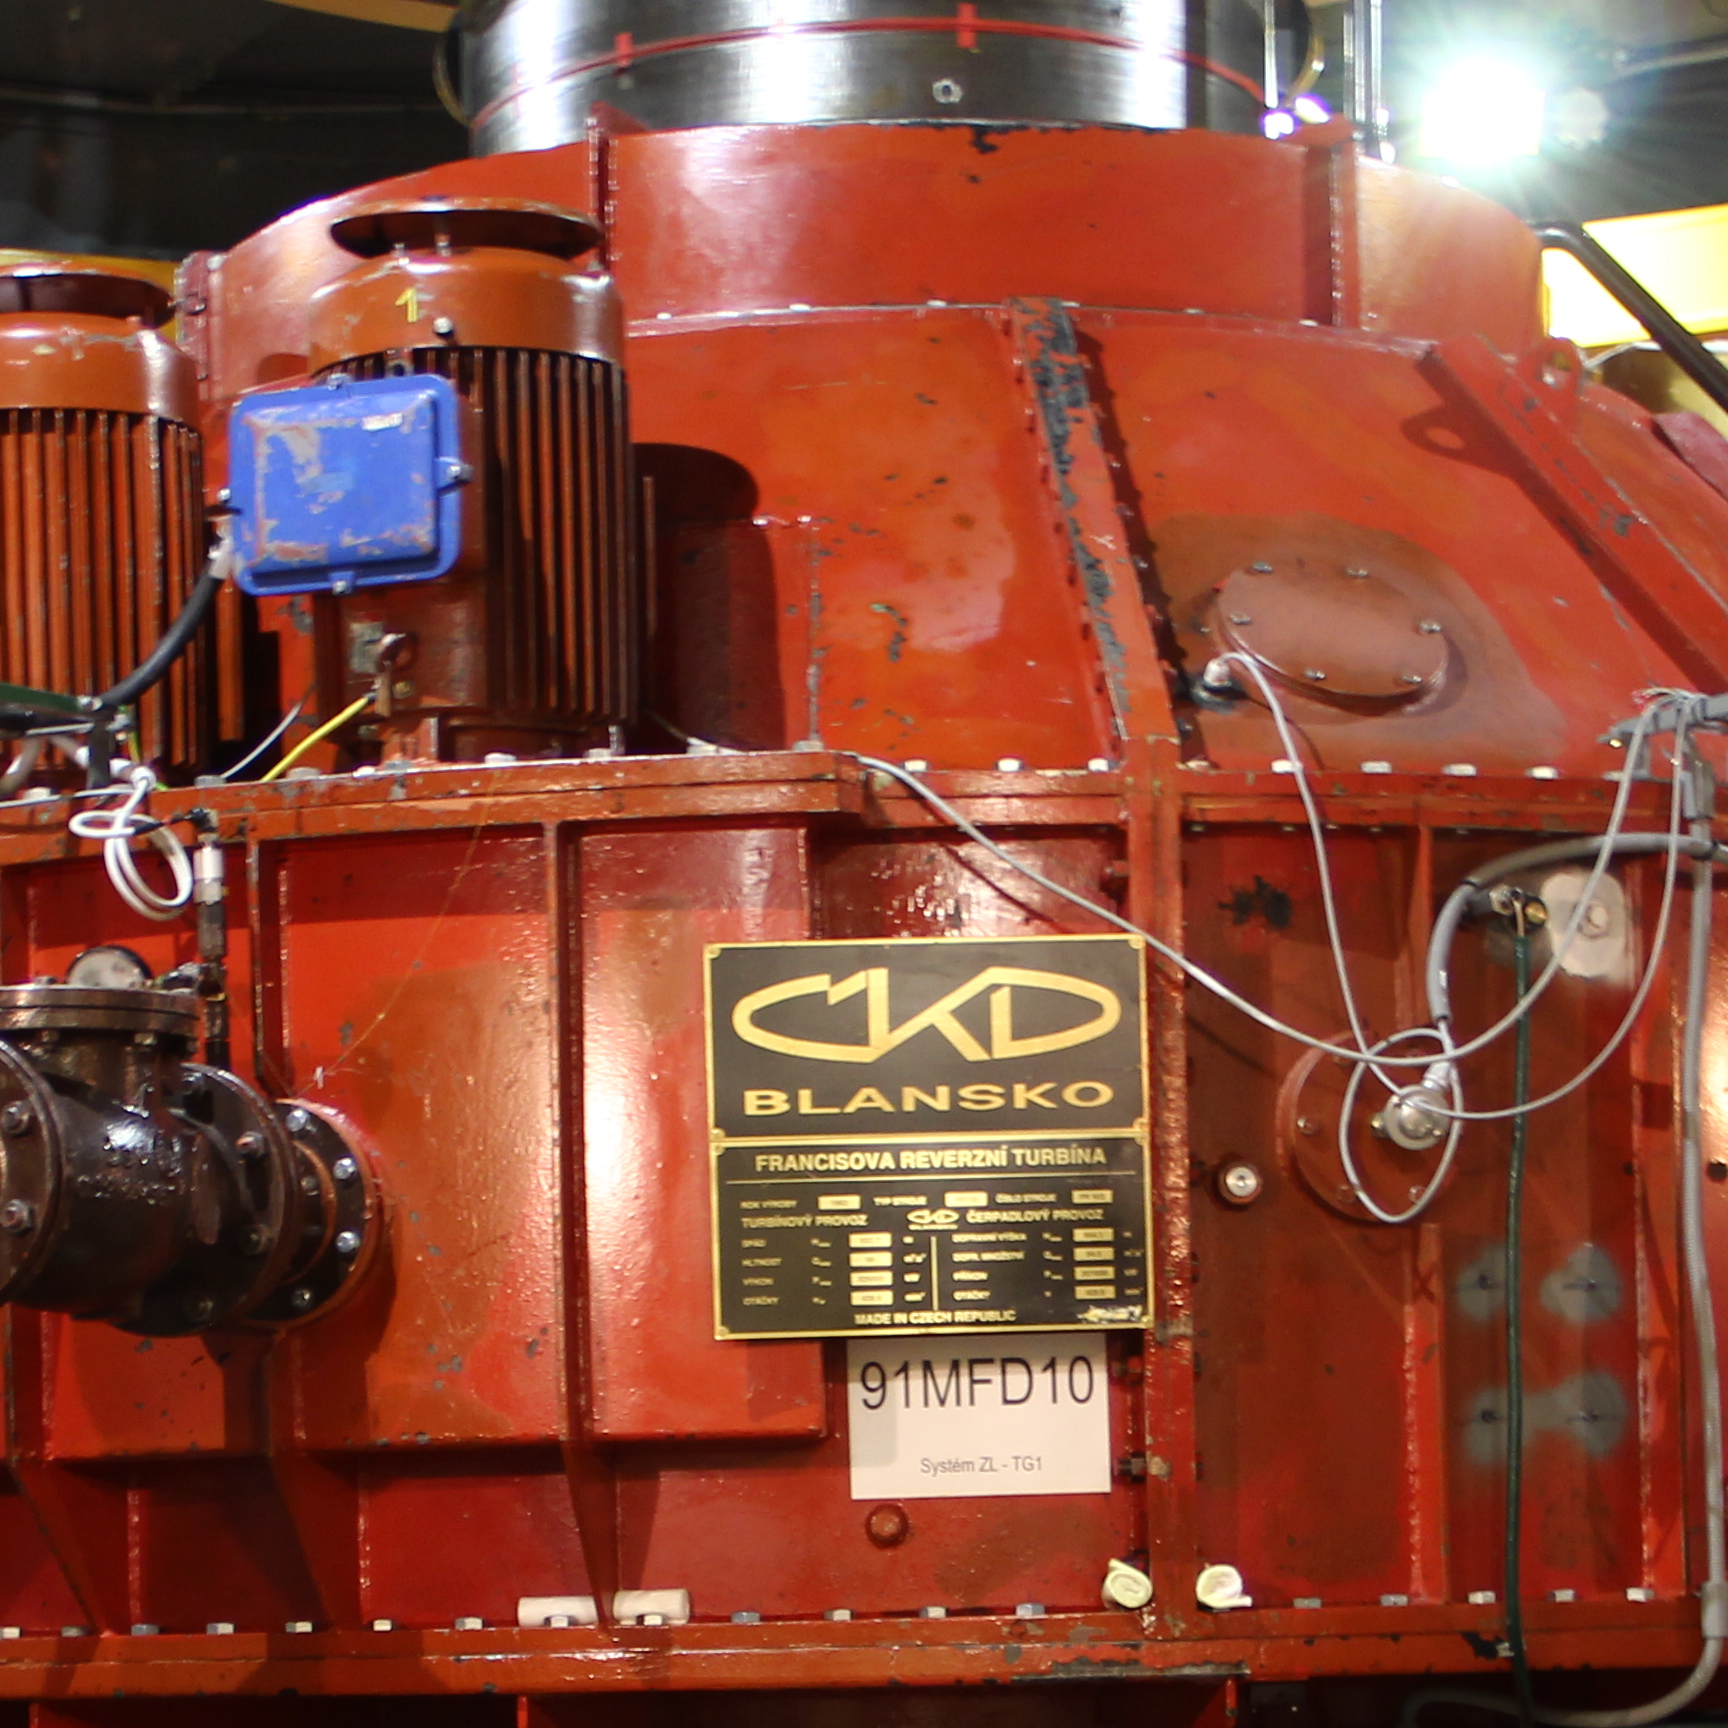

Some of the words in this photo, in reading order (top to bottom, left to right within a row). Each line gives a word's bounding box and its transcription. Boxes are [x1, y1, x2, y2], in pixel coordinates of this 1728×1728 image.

[395, 287, 418, 323] 1
[743, 1081, 1115, 1117] BLANSKO
[755, 1151, 896, 1172] FRANCISOVA
[899, 1145, 1009, 1169] REVERZNÍ
[1011, 1144, 1107, 1167] TURBÍNA
[893, 1312, 908, 1324] IN
[860, 1355, 1094, 1410] 91MFD10
[920, 1457, 975, 1477] Systém
[978, 1456, 998, 1473] ZL
[1012, 1456, 1042, 1472] TG1
